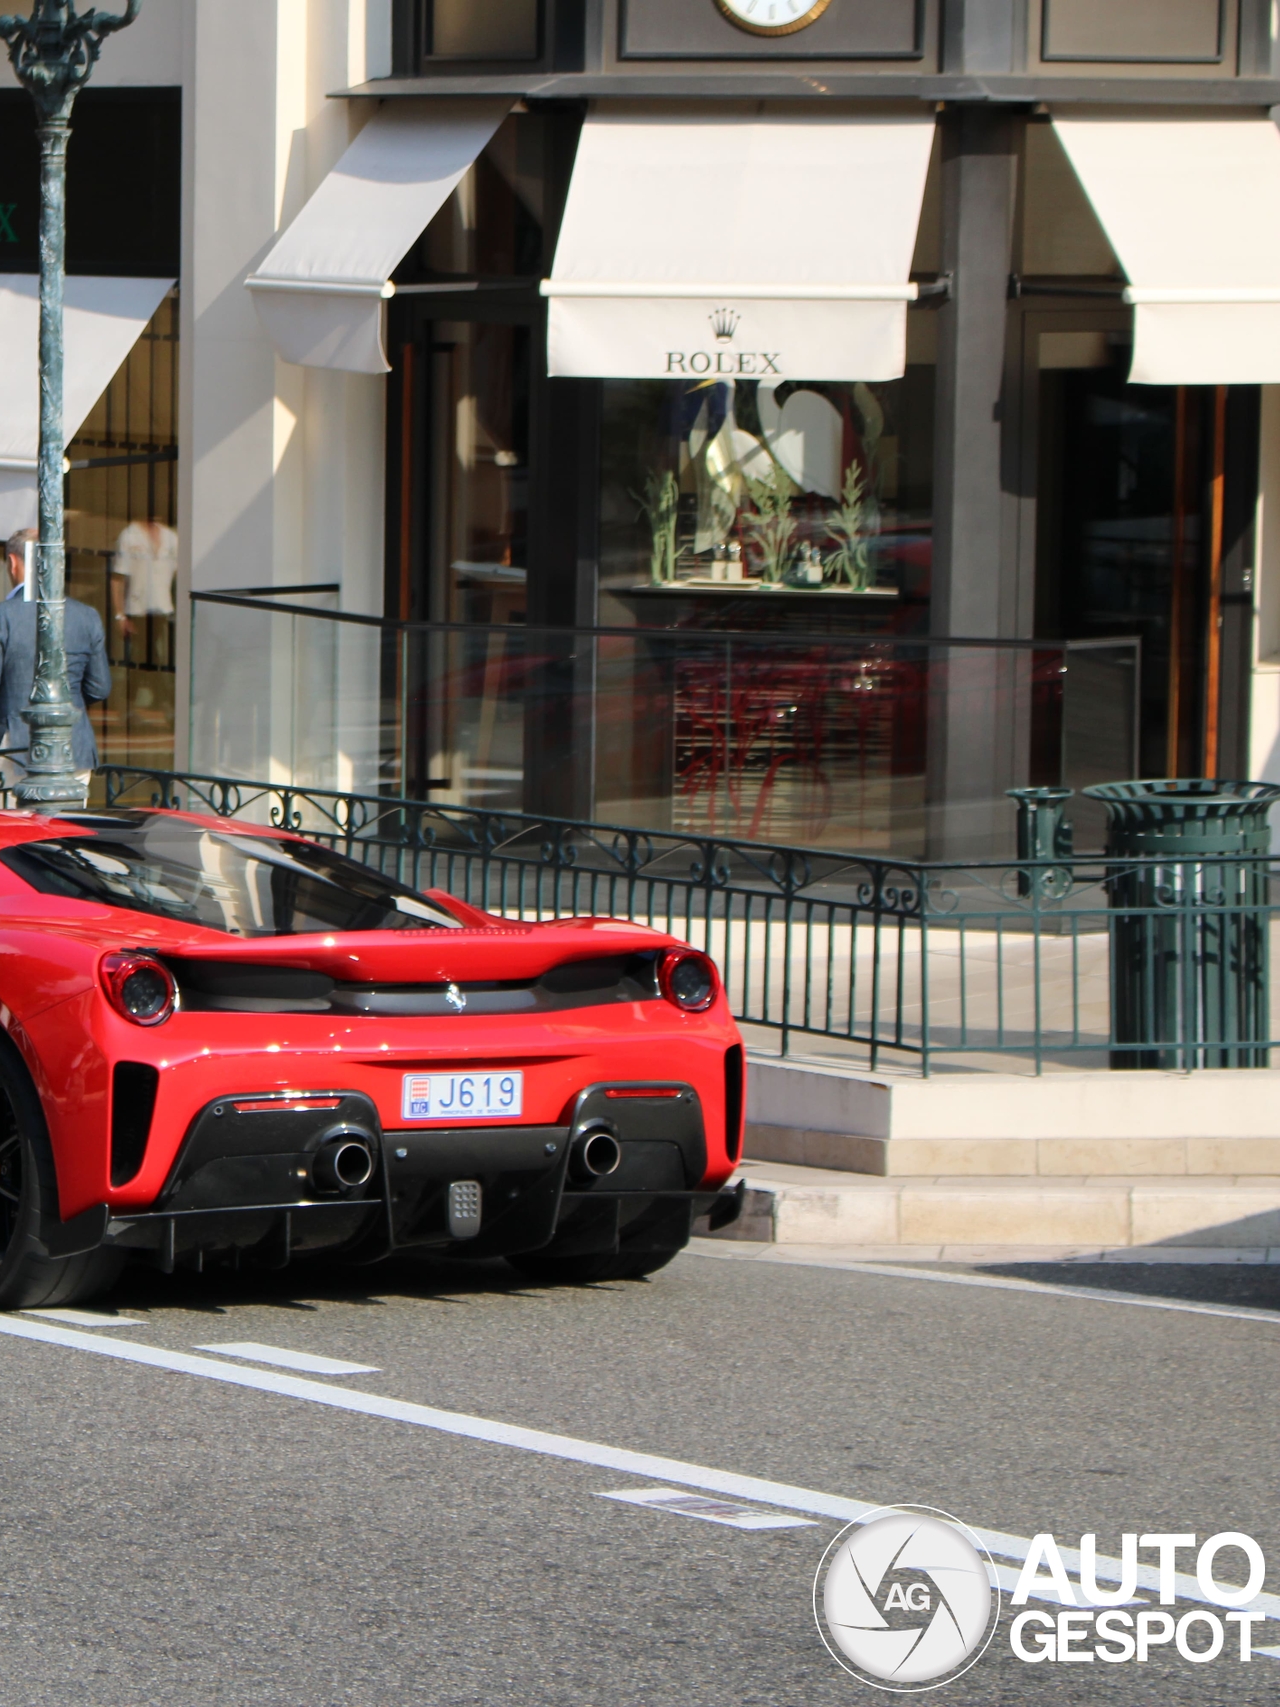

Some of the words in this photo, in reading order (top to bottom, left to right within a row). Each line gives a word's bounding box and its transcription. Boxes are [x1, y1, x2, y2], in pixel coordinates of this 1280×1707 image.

[665, 351, 782, 375] ROLEX
[439, 1077, 515, 1108] J619
[413, 1102, 427, 1113] MC
